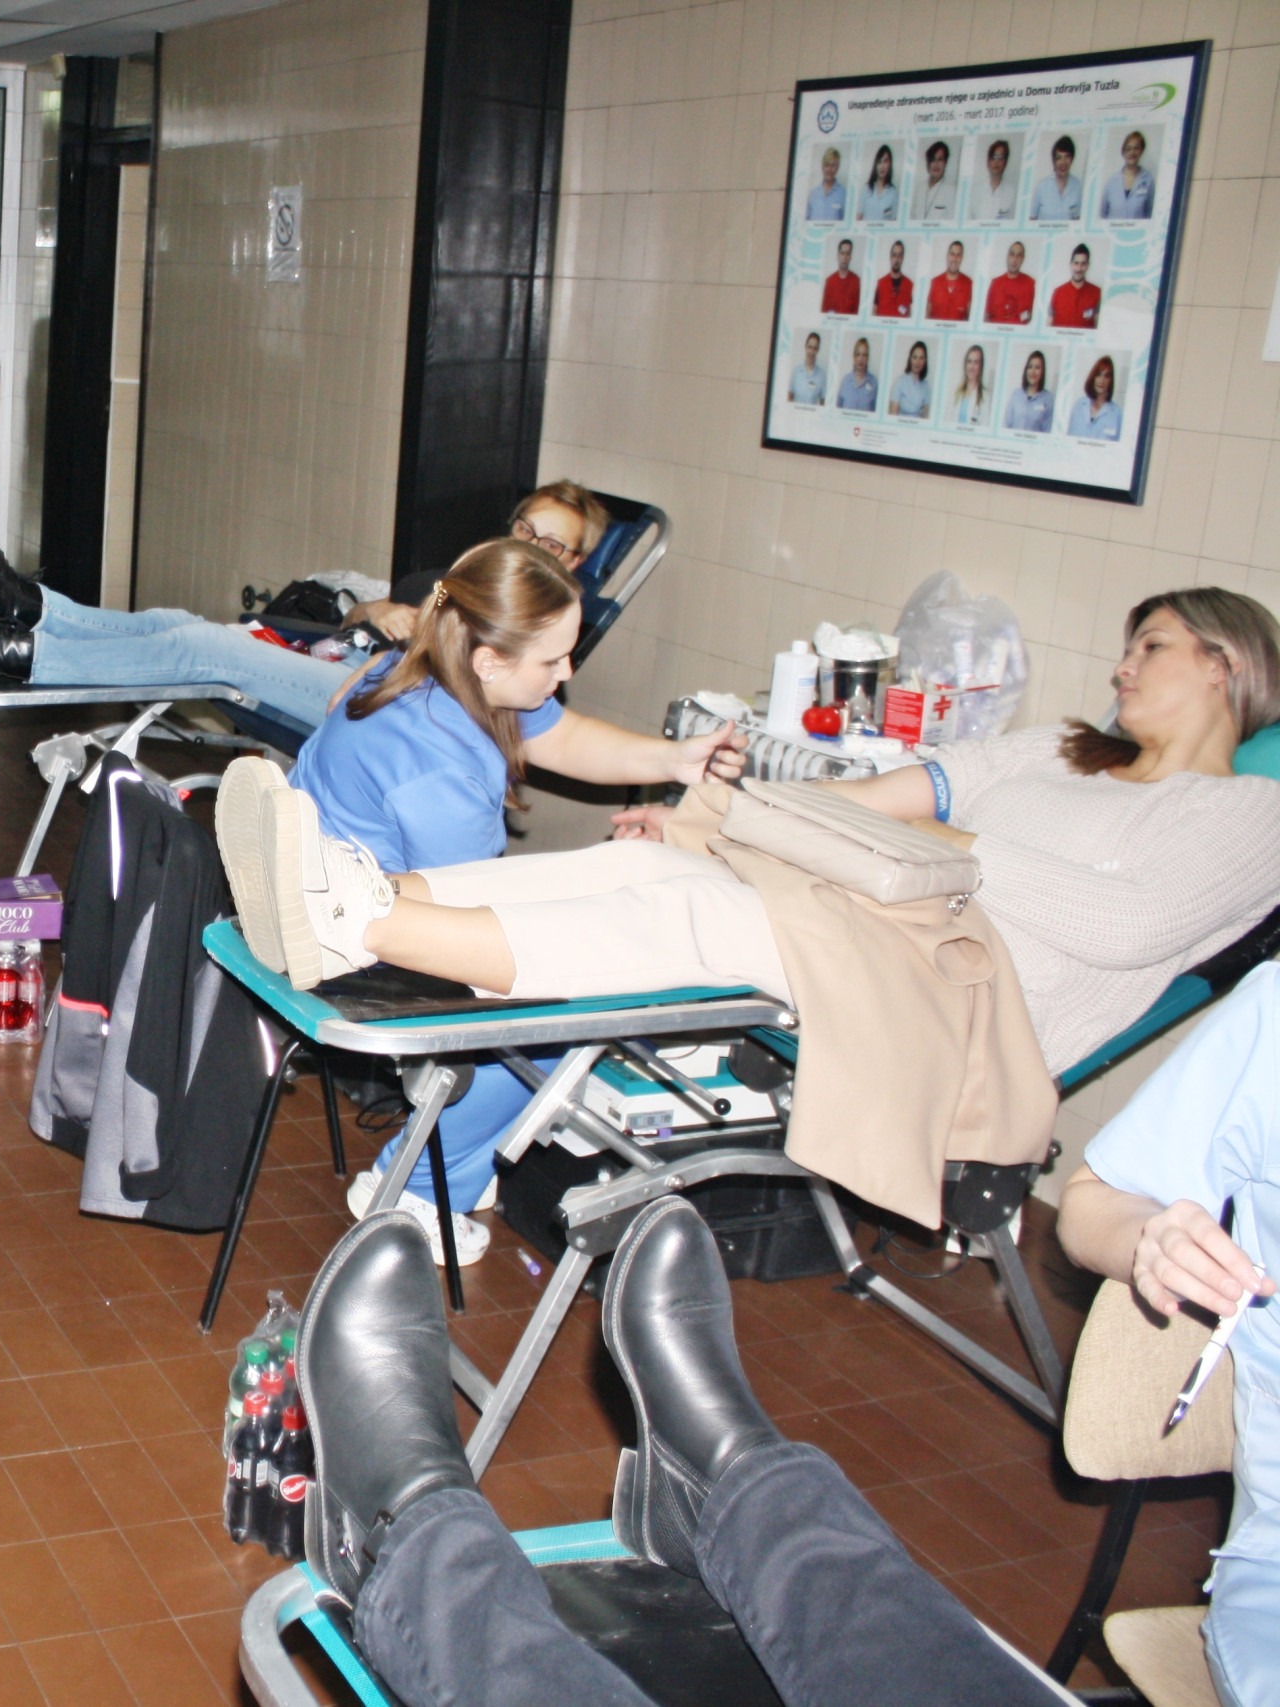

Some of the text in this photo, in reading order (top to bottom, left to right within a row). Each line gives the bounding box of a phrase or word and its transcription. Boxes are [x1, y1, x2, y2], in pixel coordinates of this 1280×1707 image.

[896, 95, 943, 107] zdravstvene
[945, 92, 968, 104] njege
[977, 88, 1015, 101] zajednici
[1025, 86, 1052, 97] Domu
[1054, 82, 1091, 97] zdravlja
[1095, 79, 1120, 92] Tuzla
[914, 111, 933, 124] (mart
[964, 109, 982, 120] mart
[1008, 104, 1039, 119] godine)
